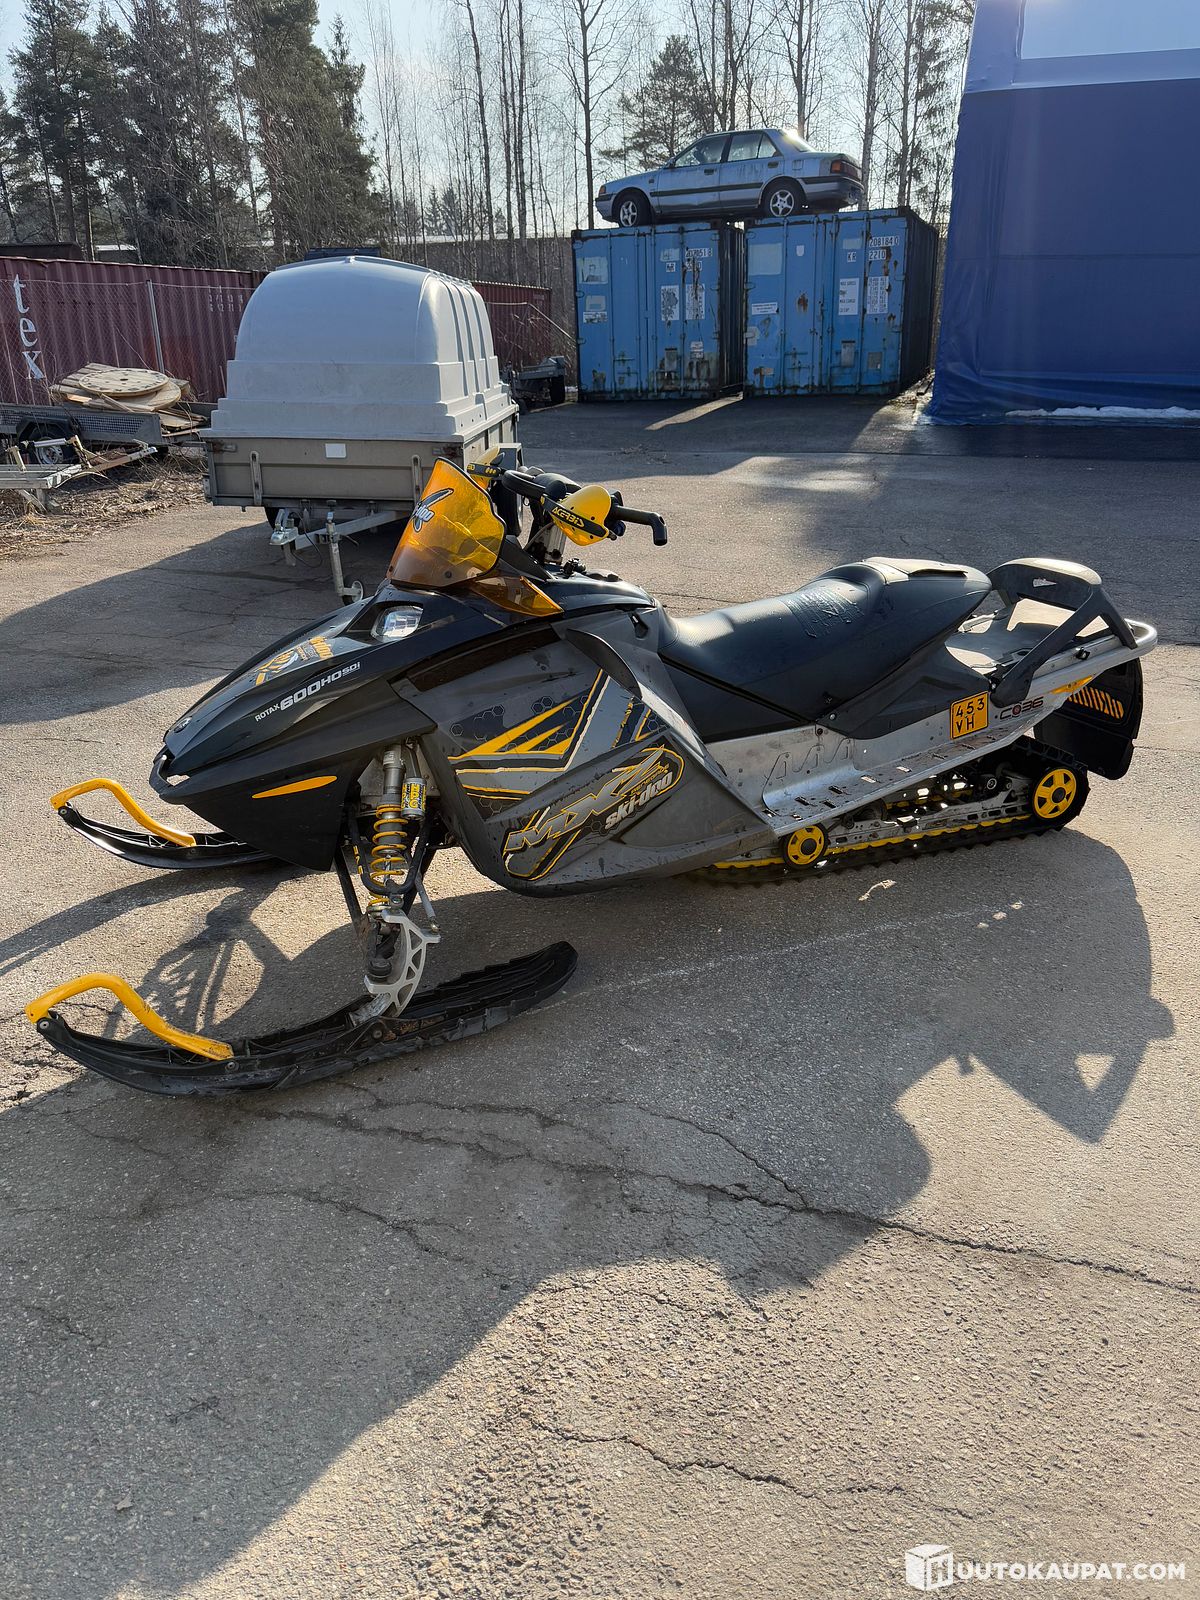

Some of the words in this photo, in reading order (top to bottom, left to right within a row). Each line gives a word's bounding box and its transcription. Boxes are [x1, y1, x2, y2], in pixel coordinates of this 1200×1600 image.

[13, 274, 45, 380] tex
[255, 703, 281, 722] ROTAX
[955, 697, 985, 719] 453
[955, 715, 975, 733] VH
[604, 771, 673, 830] ski-doo
